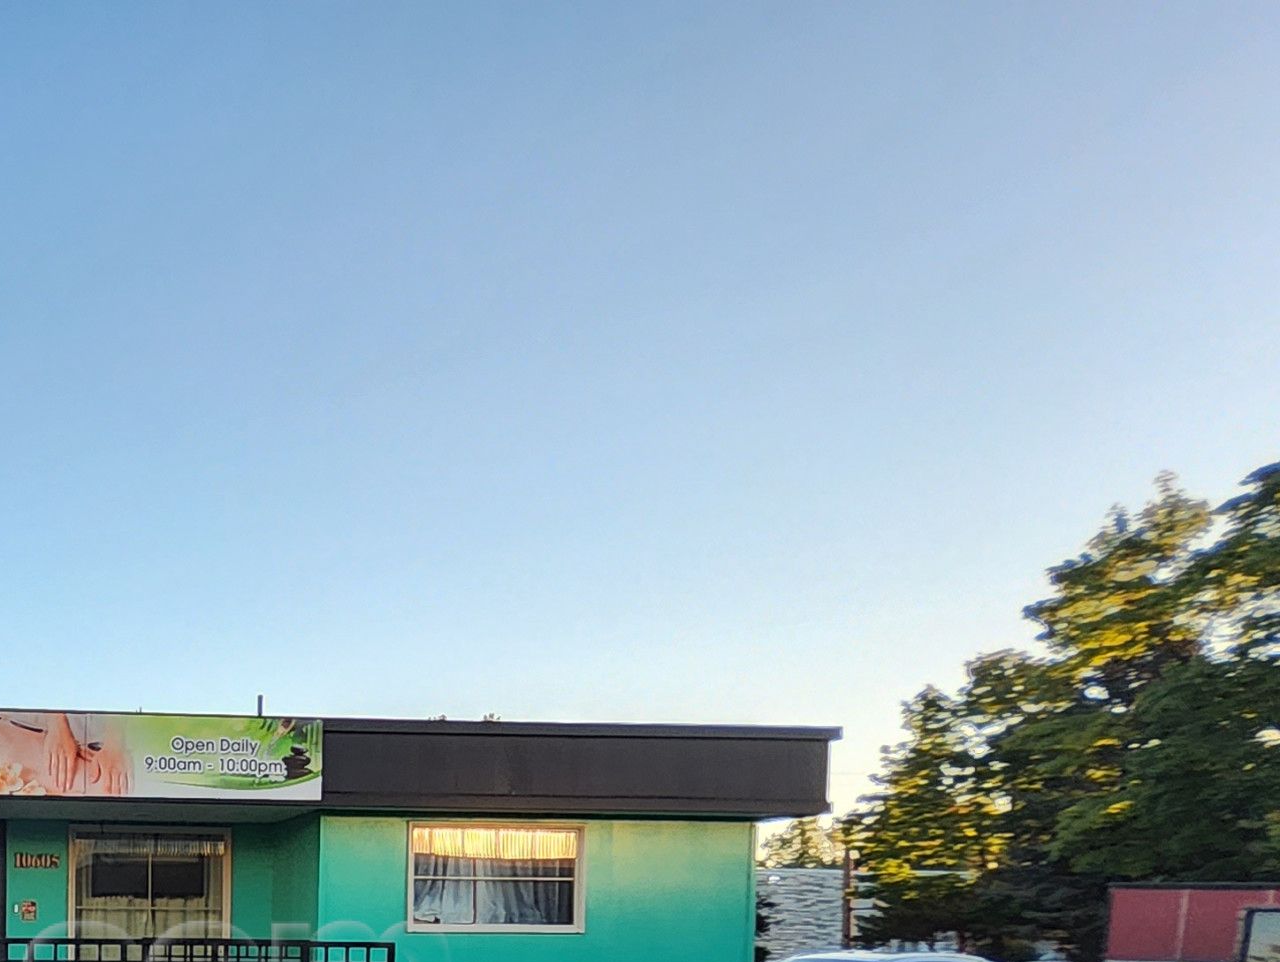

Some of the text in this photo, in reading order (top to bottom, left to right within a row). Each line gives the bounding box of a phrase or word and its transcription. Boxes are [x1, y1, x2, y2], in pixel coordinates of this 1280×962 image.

[171, 737, 258, 755] Open Daily
[145, 756, 202, 772] 9:00am
[220, 758, 283, 776] 10:00pm
